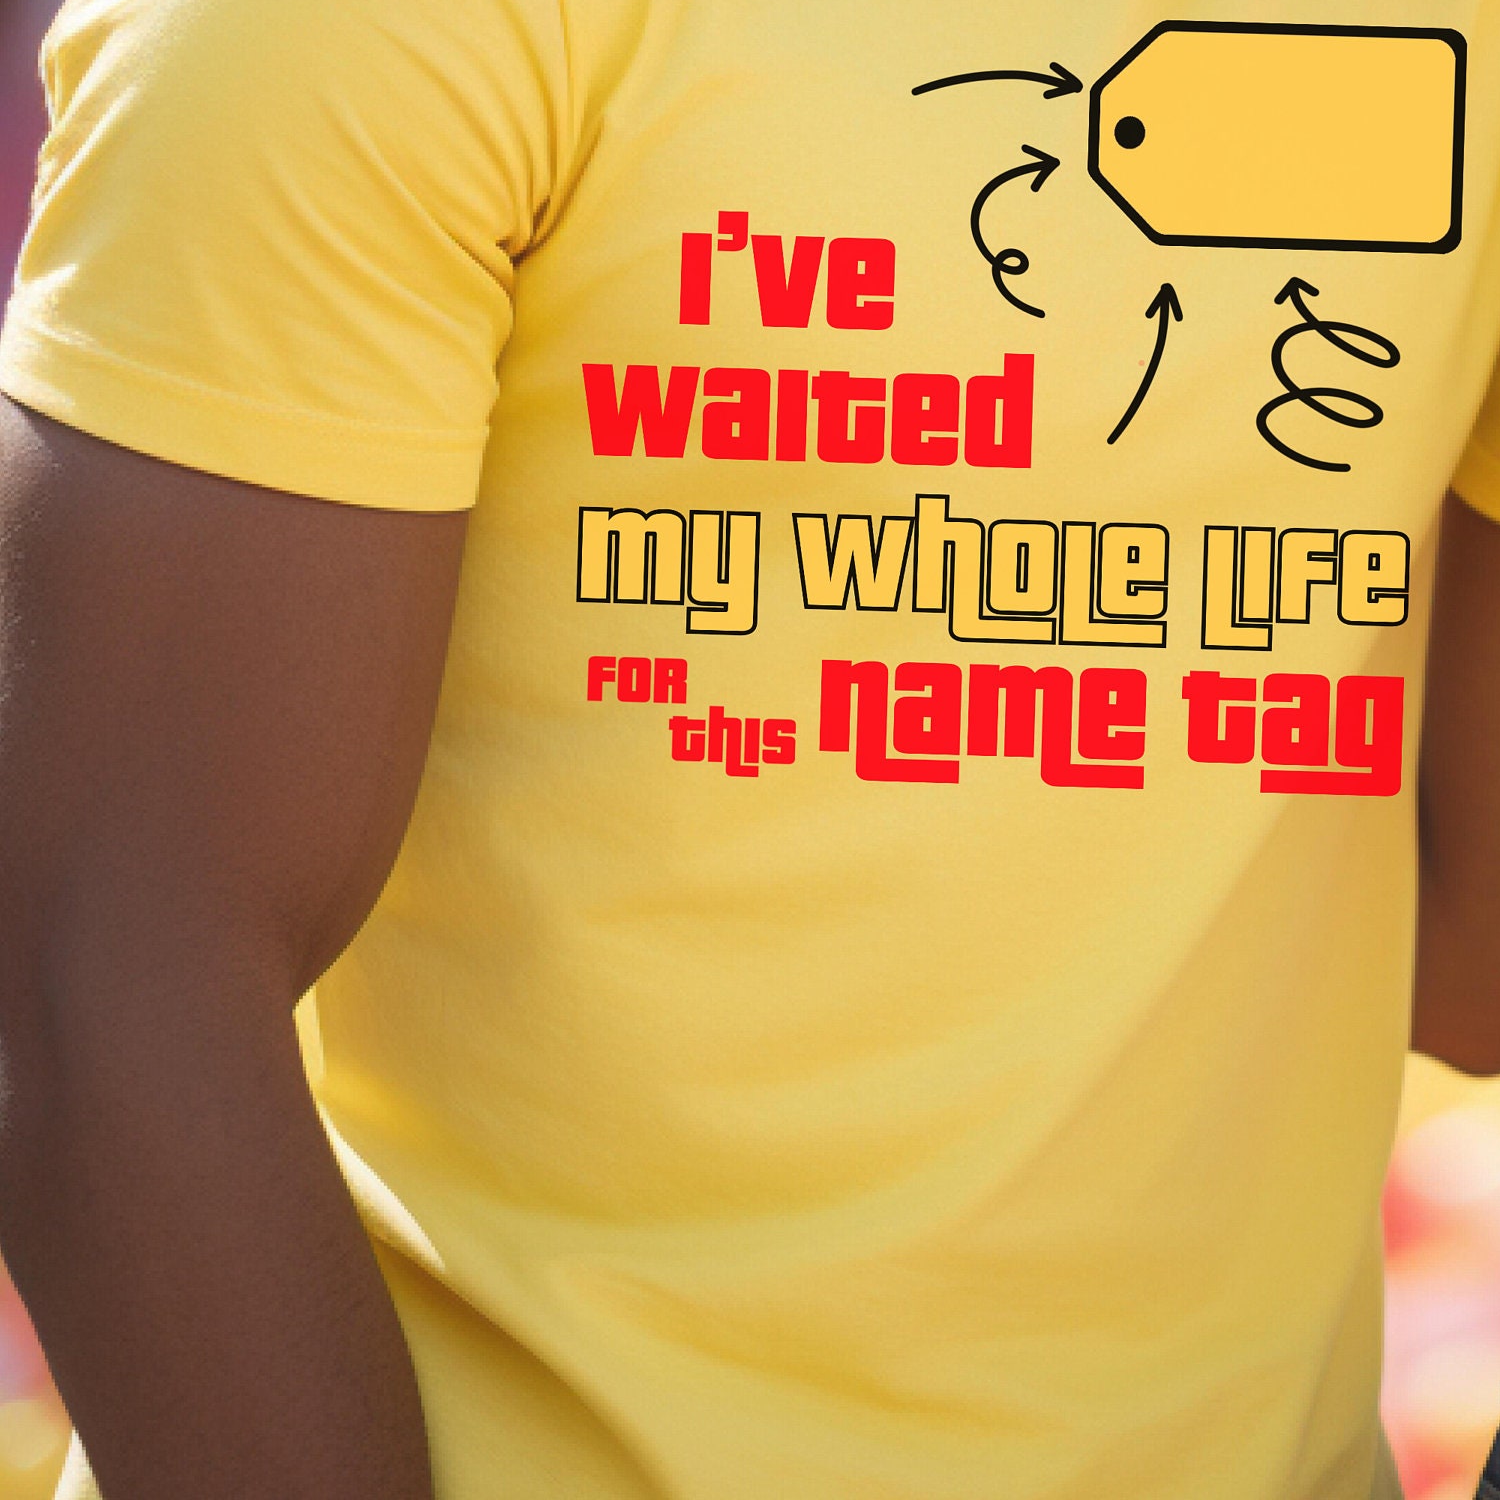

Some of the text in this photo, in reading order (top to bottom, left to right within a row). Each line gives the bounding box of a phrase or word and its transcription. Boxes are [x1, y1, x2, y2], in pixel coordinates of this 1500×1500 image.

[576, 506, 761, 636] my
[819, 659, 1147, 790] name
[1181, 670, 1405, 797] tag
